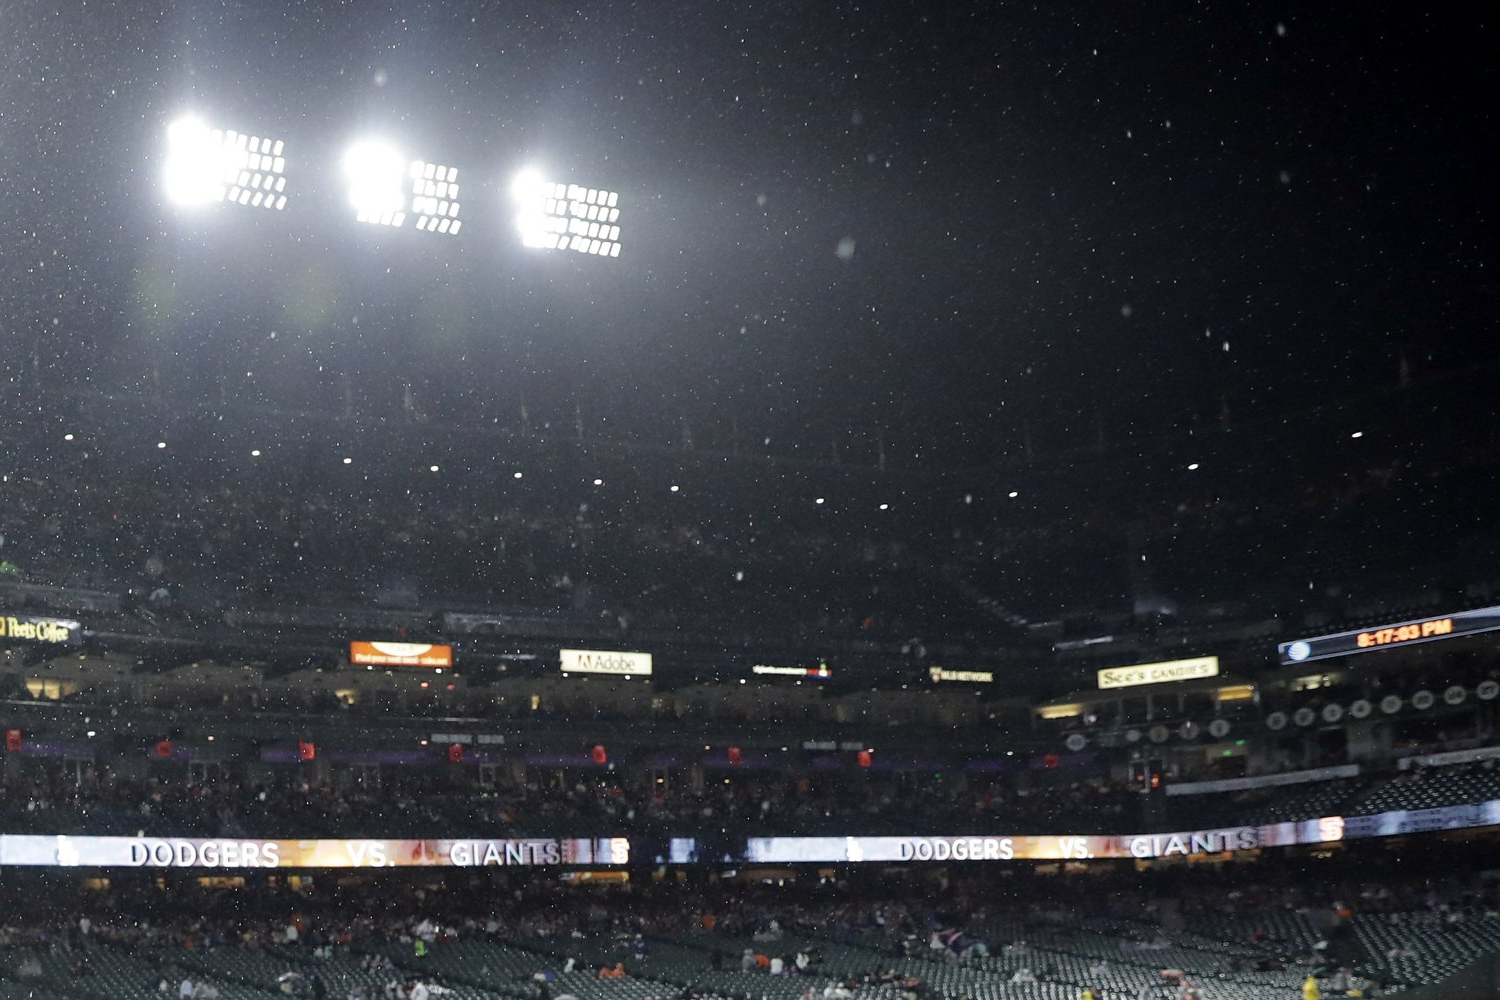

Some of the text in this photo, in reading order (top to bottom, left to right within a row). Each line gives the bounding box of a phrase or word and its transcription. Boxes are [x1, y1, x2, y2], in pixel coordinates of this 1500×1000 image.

[36, 621, 69, 643] Coffee
[1422, 618, 1453, 638] PM
[595, 655, 636, 672] Adobe
[130, 841, 562, 868] DODGERS VS. GIANTS
[900, 827, 1261, 861] DODGERS VS. GIANTS
